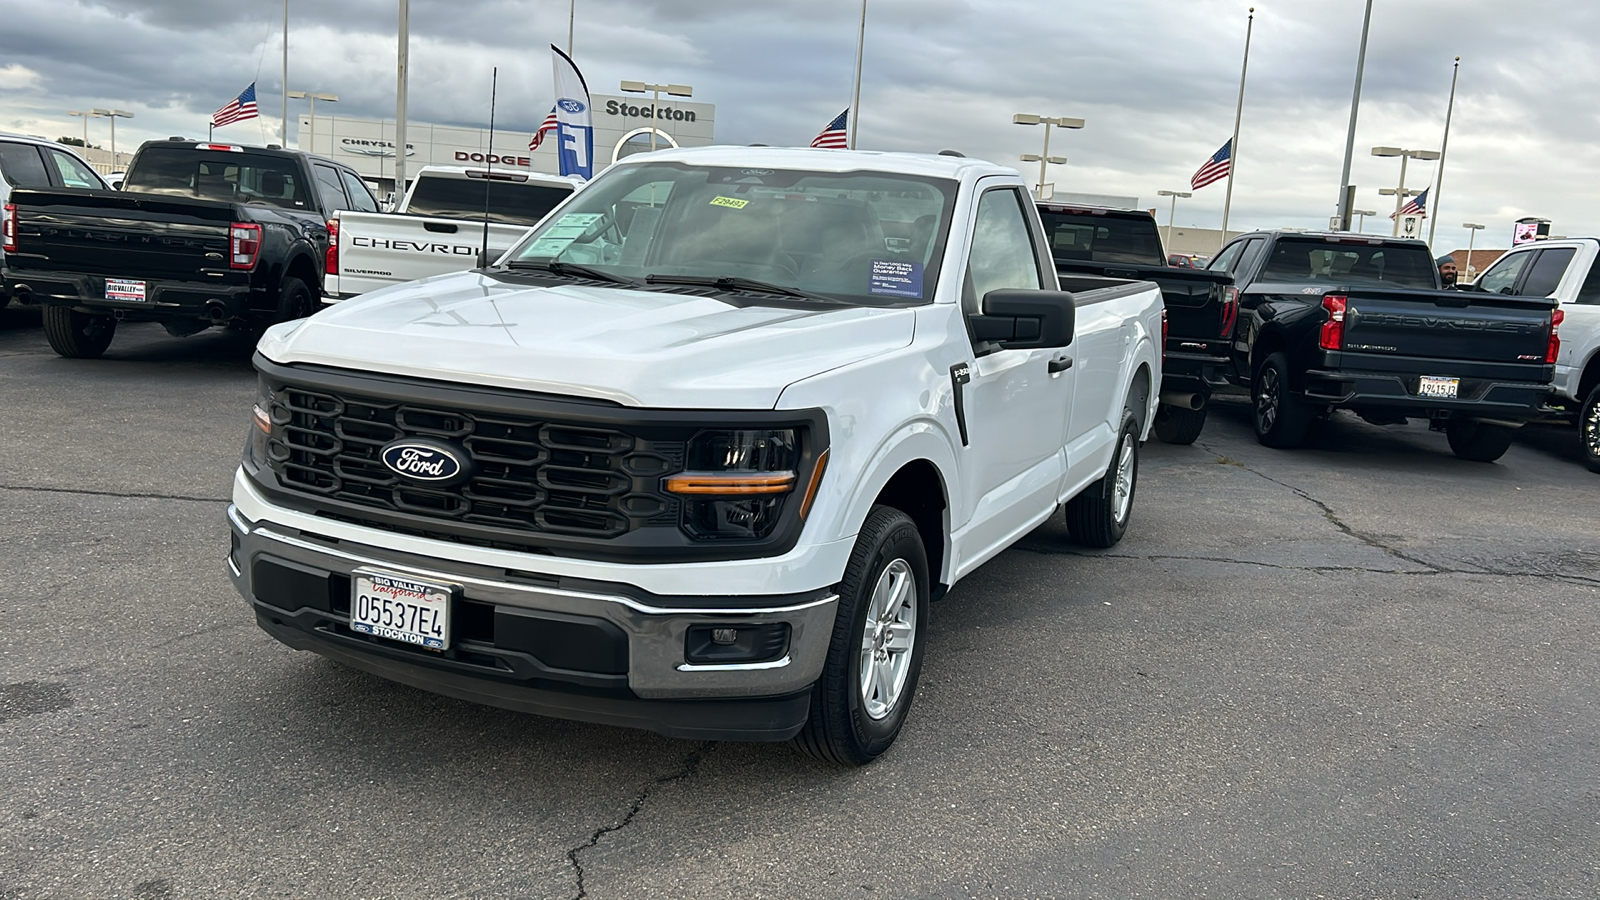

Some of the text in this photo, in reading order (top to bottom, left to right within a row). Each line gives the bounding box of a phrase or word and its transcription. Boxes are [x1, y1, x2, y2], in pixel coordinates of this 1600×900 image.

[606, 100, 696, 122] Stockton
[341, 138, 414, 150] CHRYSLR
[455, 151, 531, 167] DODGE
[50, 229, 194, 247] PLATINUM
[353, 237, 478, 256] CHEVRO
[344, 268, 392, 276] SILVERADO
[1361, 313, 1544, 334] CHEVROLET
[1347, 343, 1397, 351] SILVERADO
[1422, 383, 1456, 395] 19415J3
[396, 448, 445, 476] Ford
[373, 583, 433, 603] California
[375, 576, 426, 593] BIG VALLEY
[359, 594, 443, 638] 05537E4
[372, 626, 424, 645] STOCKTON
